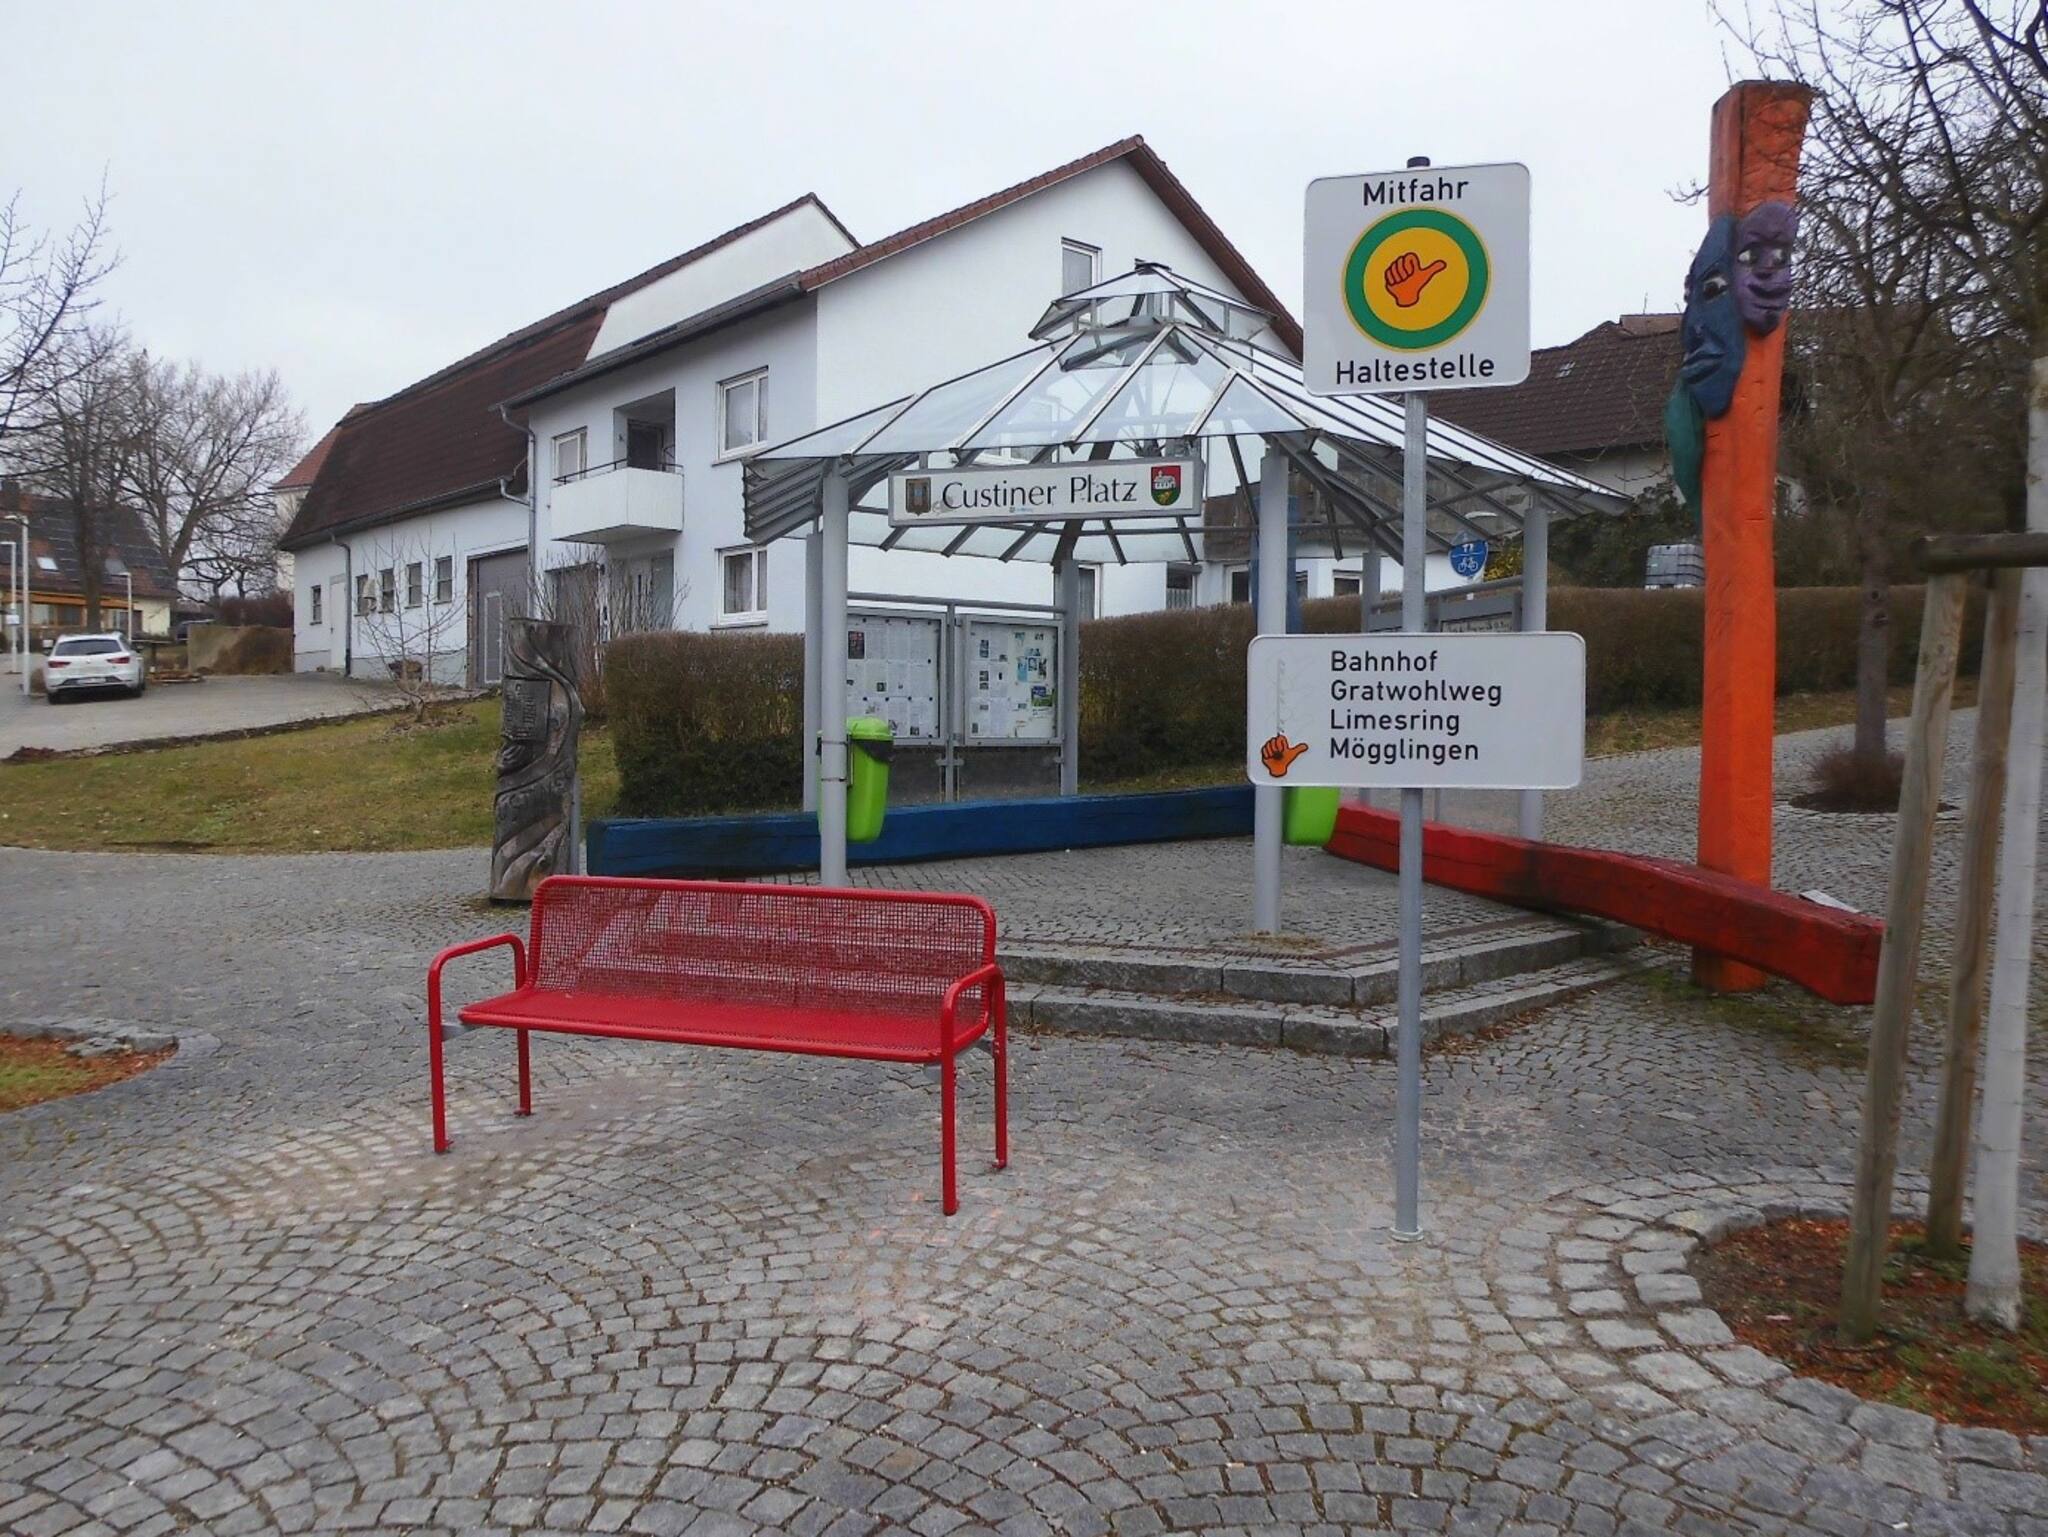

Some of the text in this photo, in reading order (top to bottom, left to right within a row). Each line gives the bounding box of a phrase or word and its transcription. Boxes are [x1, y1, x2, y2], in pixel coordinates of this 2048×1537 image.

[1363, 177, 1469, 206] Mitfahr
[1336, 353, 1495, 385] Haltestelle
[942, 474, 1138, 510] Custiner Platz
[1331, 650, 1438, 672] Bahnhof
[1330, 679, 1502, 707] Gratwohlweg
[1330, 708, 1460, 737] Limesring
[1329, 737, 1479, 766] Mögglingen
